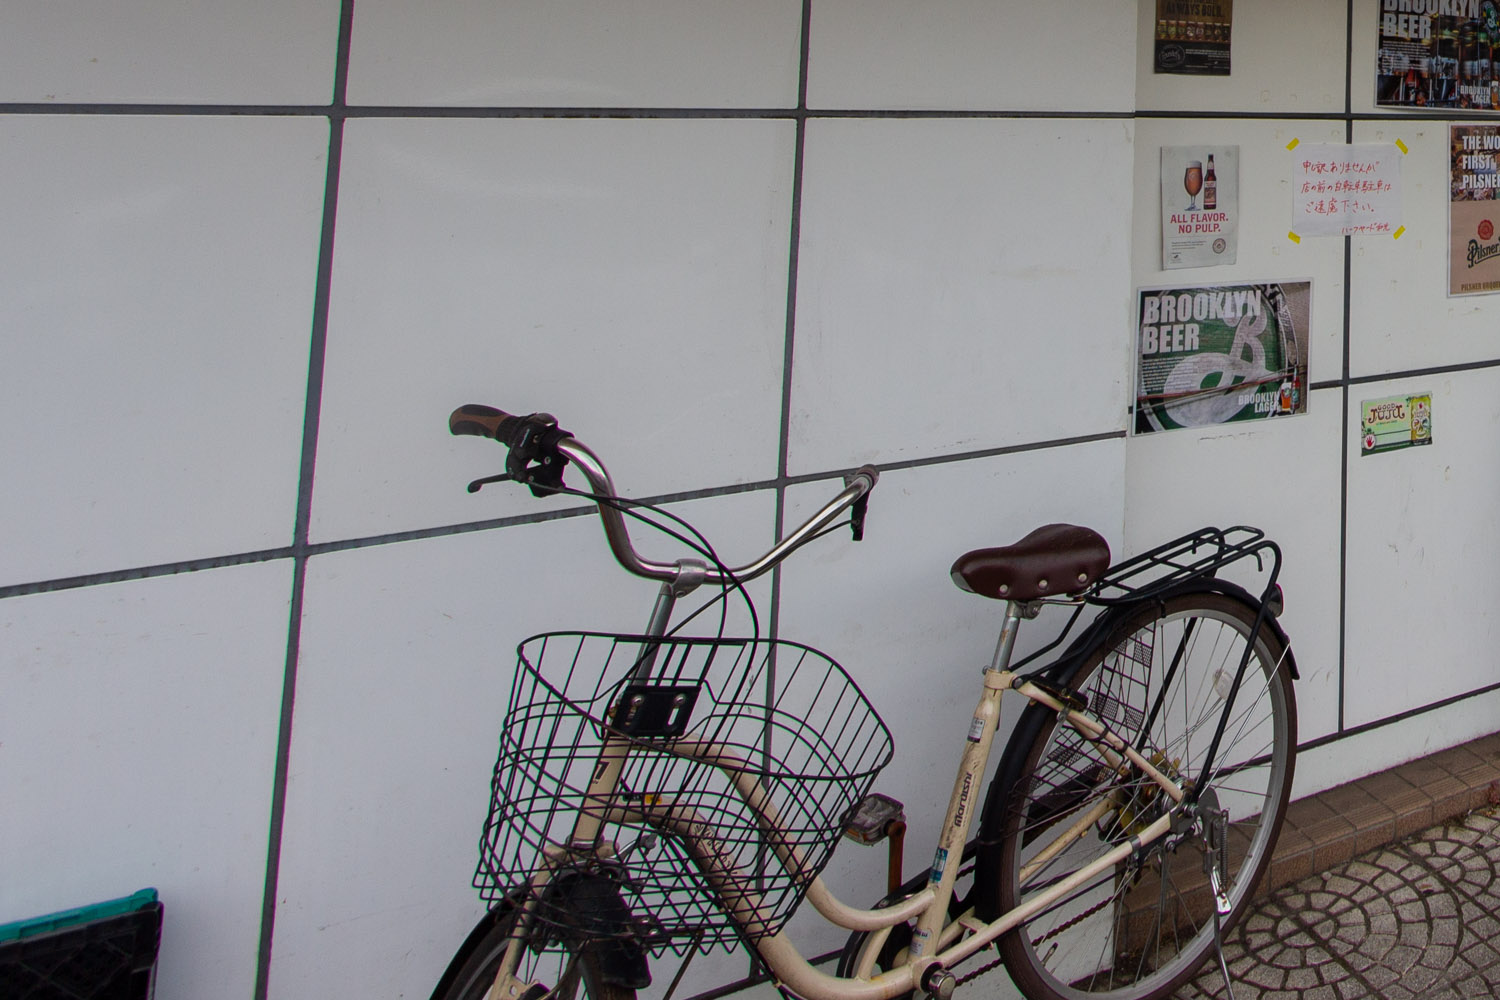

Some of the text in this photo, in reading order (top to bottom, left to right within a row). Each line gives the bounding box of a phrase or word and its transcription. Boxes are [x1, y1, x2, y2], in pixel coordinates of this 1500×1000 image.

[1383, 12, 1432, 40] BEER
[1460, 84, 1491, 95] BROOKLYN
[1472, 94, 1491, 104] LAGER
[1462, 135, 1481, 150] THE
[1302, 160, 1380, 175] 申し訳ありませんが
[1462, 155, 1493, 170] FIRST
[1170, 212, 1229, 224] ALL FLAVOR.
[1178, 223, 1221, 234] NO PULP.
[1467, 237, 1499, 269] Pilsner
[1143, 290, 1262, 325] BROOKLYN
[1142, 323, 1200, 355] BEER
[1238, 391, 1281, 406] BROOKLYN
[1254, 401, 1281, 413] LAGER
[1368, 404, 1406, 424] JUJU
